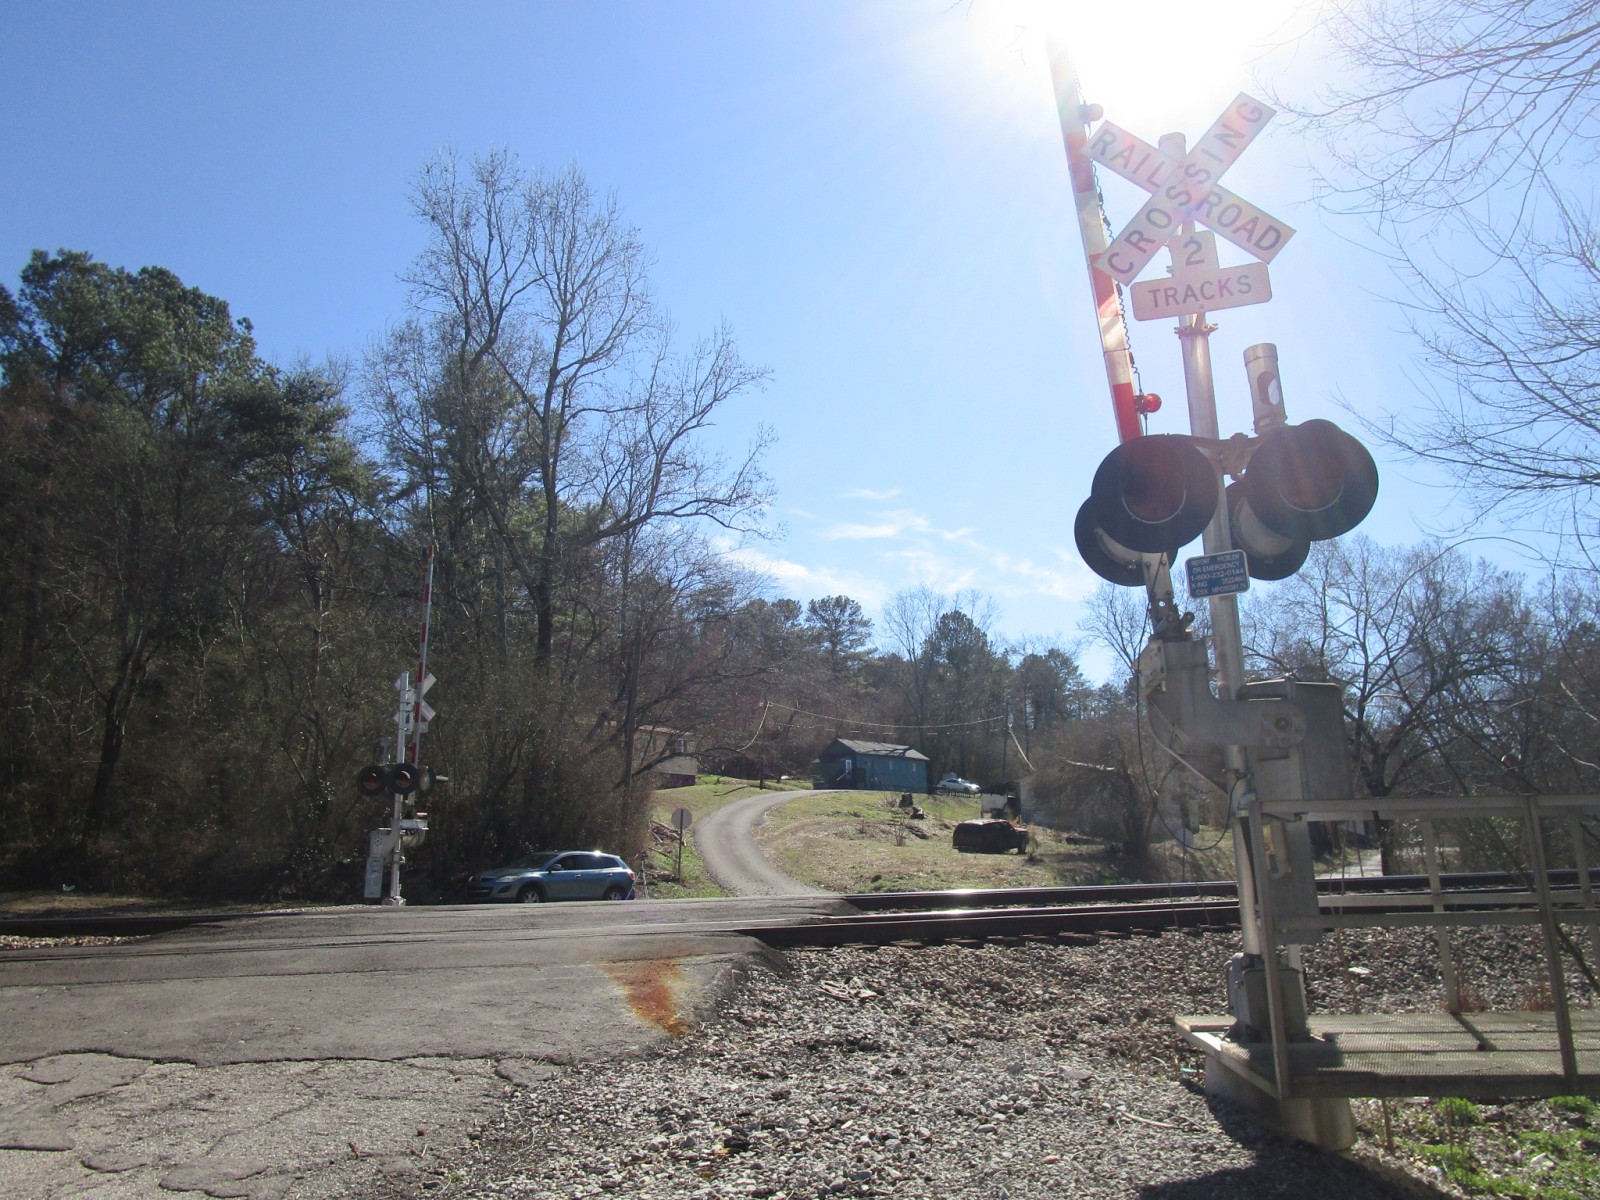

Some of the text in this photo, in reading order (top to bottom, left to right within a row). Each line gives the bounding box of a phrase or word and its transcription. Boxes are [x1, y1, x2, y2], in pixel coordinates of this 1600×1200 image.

[1090, 128, 1282, 251] RAIL ROAD
[1107, 101, 1264, 275] CROSSING
[1182, 239, 1205, 266] 2
[1148, 274, 1253, 308] TRACKS
[1202, 561, 1240, 572] EMERGENCY
